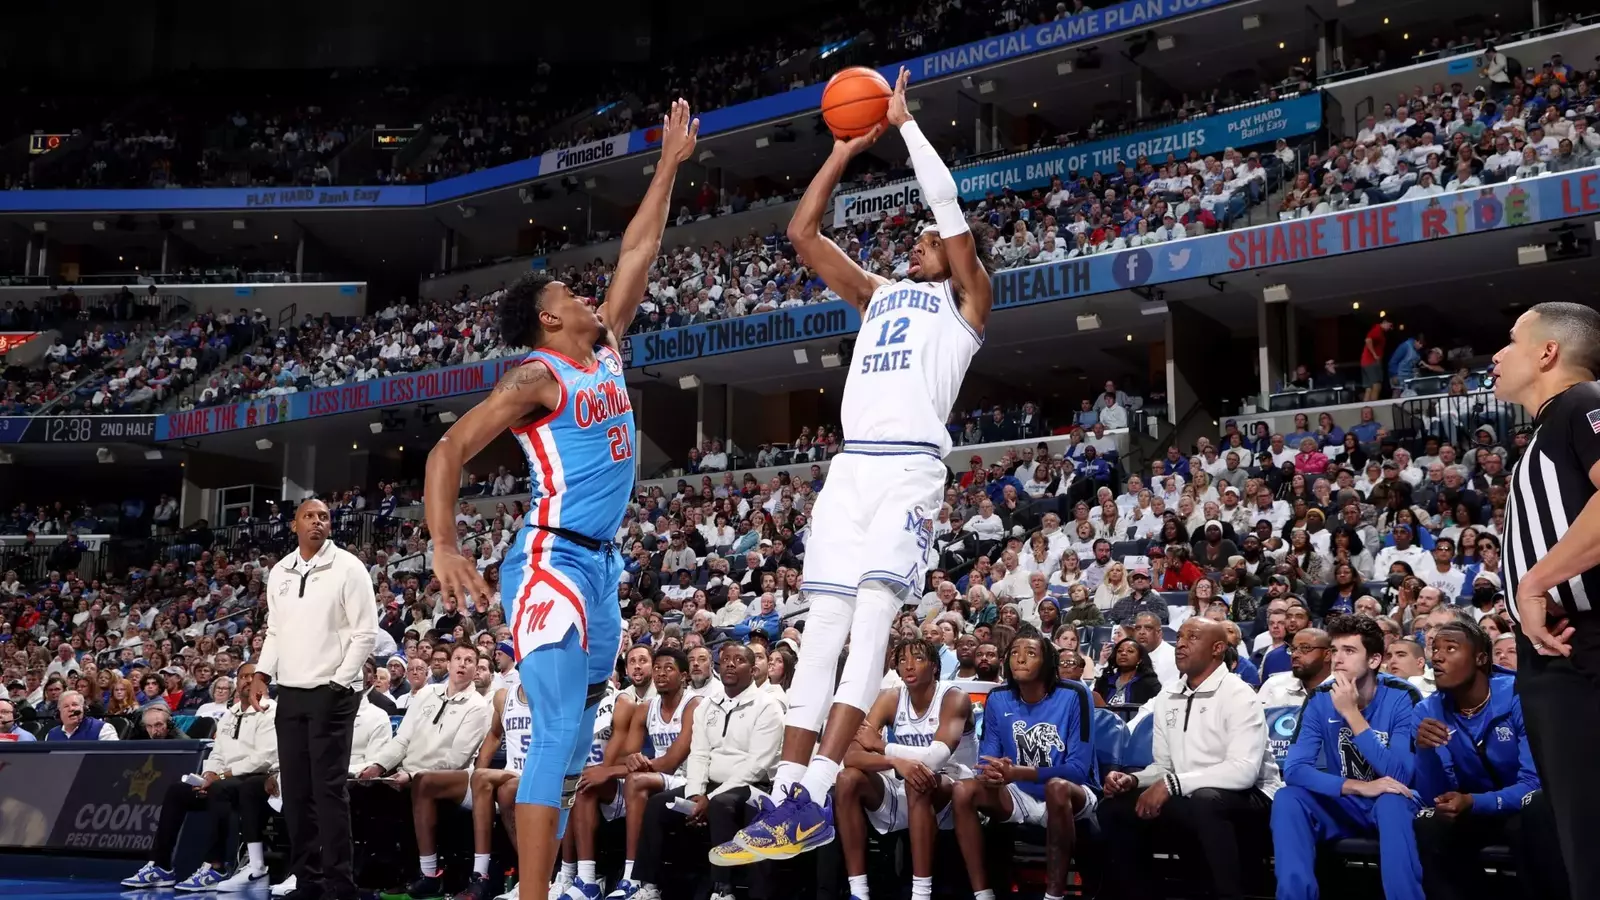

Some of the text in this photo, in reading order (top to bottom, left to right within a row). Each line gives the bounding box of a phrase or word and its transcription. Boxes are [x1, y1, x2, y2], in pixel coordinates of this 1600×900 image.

[923, 0, 1163, 77] FINANCIAL GAME PLAN
[1227, 107, 1282, 133] PLAY HARD
[1241, 118, 1288, 140] Bank Easy
[556, 140, 614, 169] Pinnacle
[960, 128, 1206, 194] OFFICIAL BANK OF THE GRIZZLIES
[246, 188, 381, 206] PLAY HARD Bank Easy
[844, 186, 920, 218] Pinnacle
[1228, 216, 1328, 271] SHARE
[1340, 205, 1399, 252] THE
[1421, 186, 1531, 238] RIDE
[866, 288, 941, 324] MEMPHIS
[644, 308, 847, 361] ShelbyTNHealth.com
[876, 316, 910, 347] 12
[861, 349, 912, 374] STATE
[168, 408, 210, 440] SHARE
[214, 404, 239, 431] THE
[308, 388, 340, 415] LESS
[574, 387, 608, 429] Ole
[45, 419, 92, 442] 12:38
[101, 423, 123, 436] 2ND
[126, 422, 154, 436] HALF
[607, 423, 633, 462] 21
[526, 600, 555, 635] M
[505, 716, 532, 731] MEMP
[74, 803, 163, 832] COOK'S
[65, 832, 99, 848] PEST
